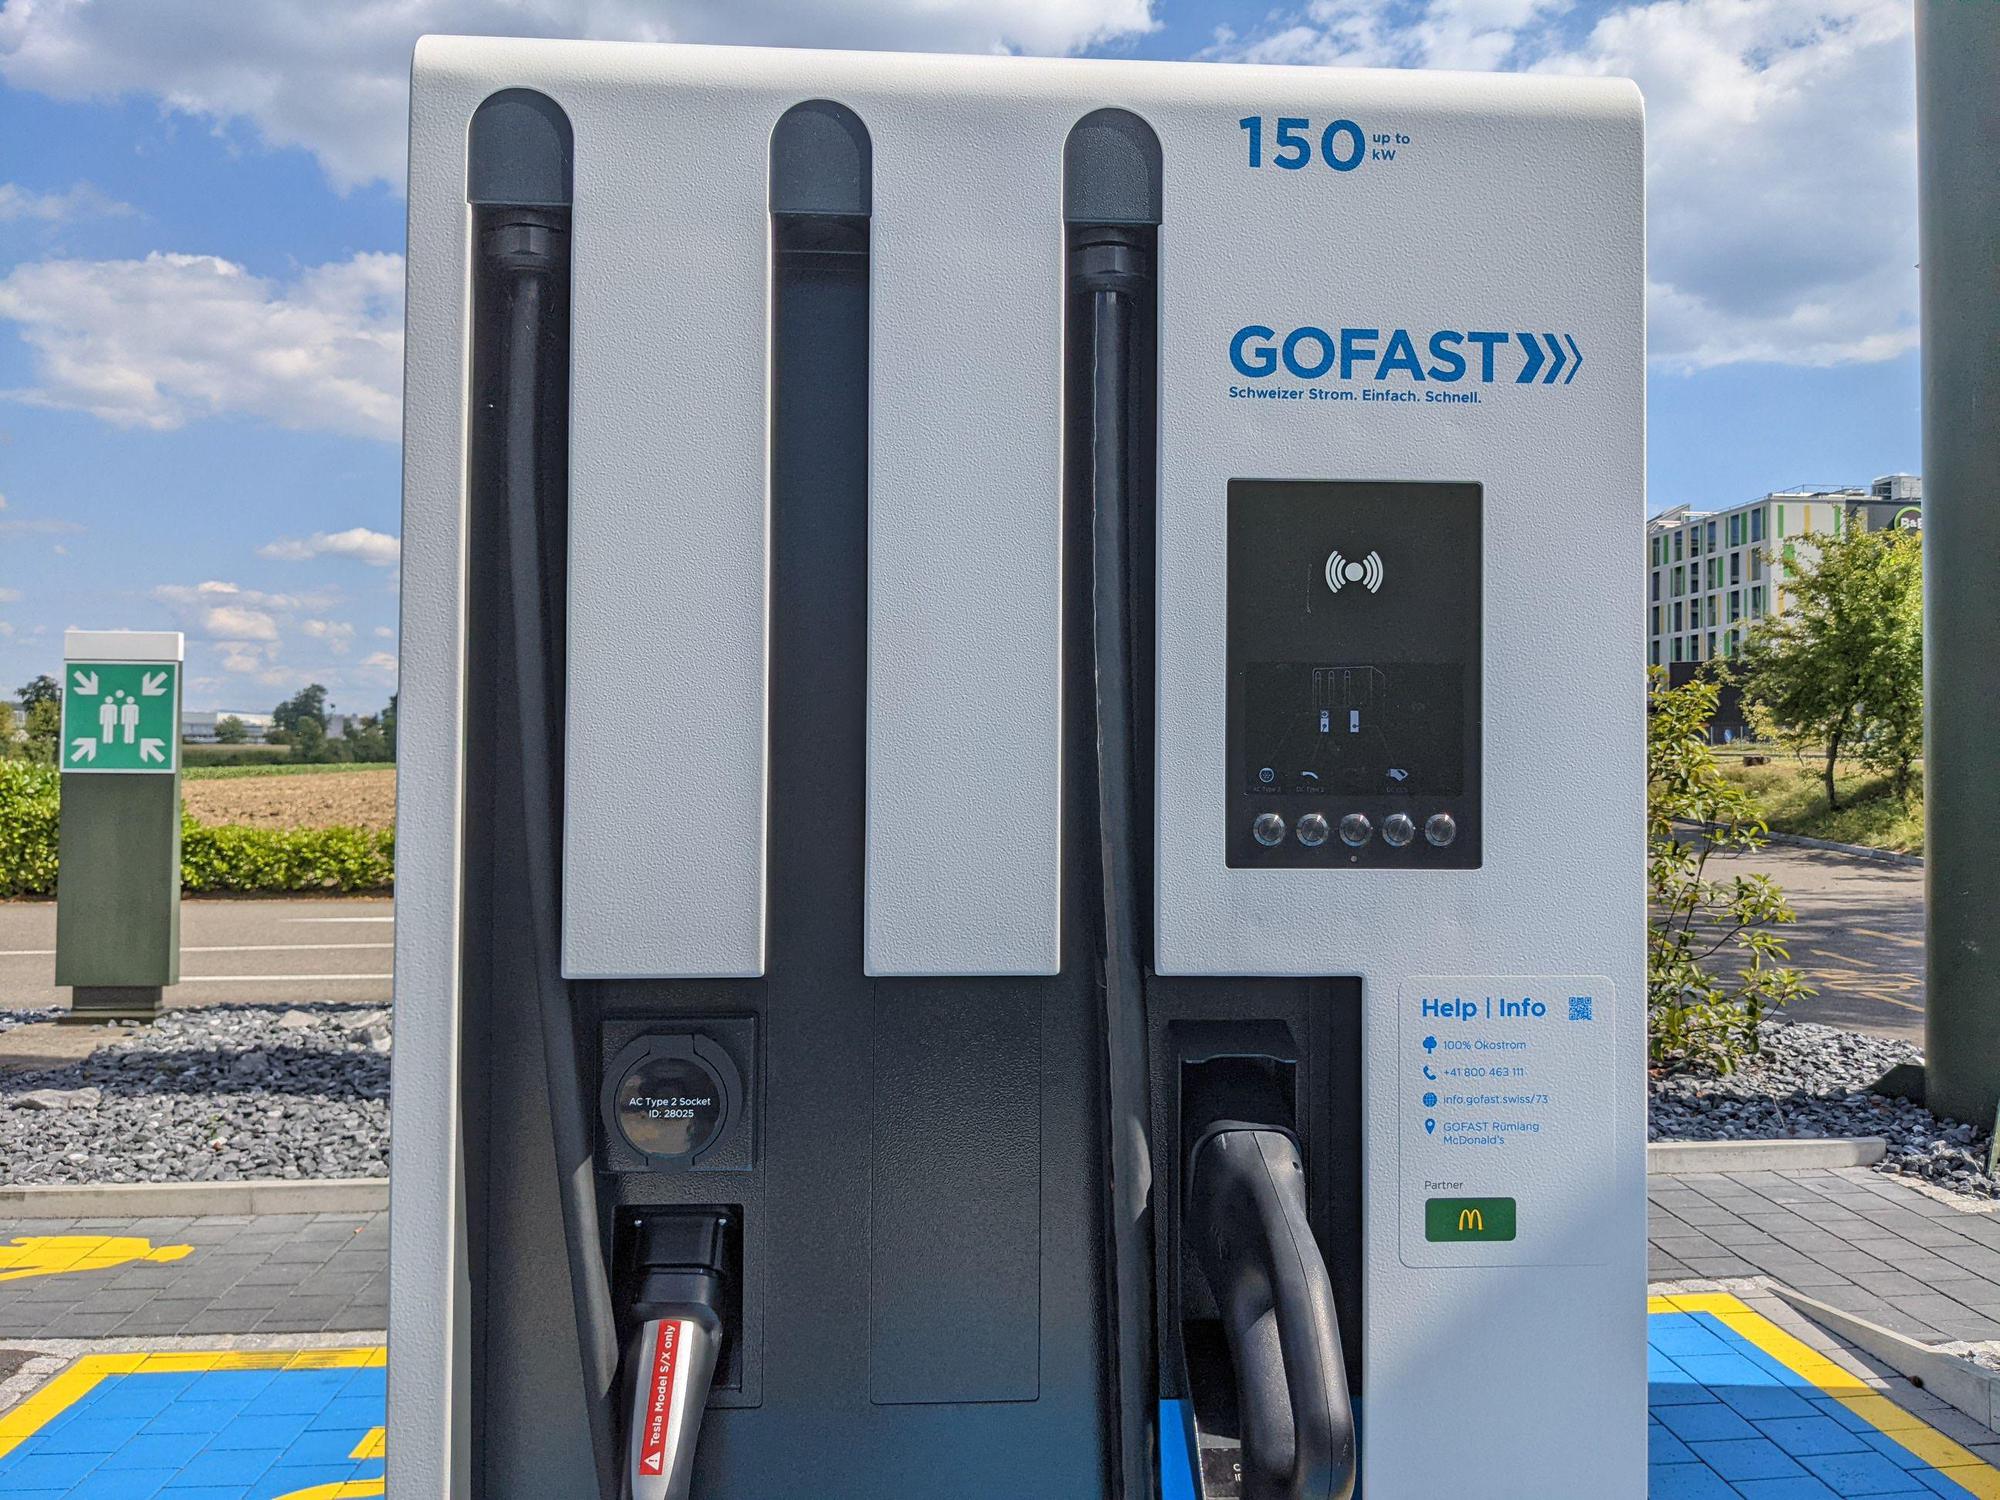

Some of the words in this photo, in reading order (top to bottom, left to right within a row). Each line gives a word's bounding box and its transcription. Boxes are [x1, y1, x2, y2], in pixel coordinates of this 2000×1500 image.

[1238, 116, 1366, 172] 150
[1372, 133, 1391, 146] up
[1395, 133, 1411, 144] to
[1372, 149, 1396, 161] kW
[1229, 325, 1509, 383] GOFAST
[1229, 386, 1305, 400] Schweizer
[1308, 388, 1358, 401] Strom.
[1362, 389, 1420, 402] Einfach.
[1425, 390, 1482, 404] Schnell.
[1422, 998, 1478, 1022] Help
[1499, 997, 1546, 1017] Info
[1443, 1040, 1472, 1050] 100%
[1444, 1067, 1461, 1077] +41
[1464, 1067, 1486, 1077] 800
[1489, 1067, 1510, 1077] 463
[1512, 1067, 1524, 1077] 111
[629, 1097, 643, 1106] AC
[645, 1097, 669, 1108] Type
[671, 1097, 677, 1106] 2
[679, 1097, 711, 1106] Socket
[1443, 1094, 1549, 1106] info.gofast.swiss/73
[649, 1109, 662, 1118] ID:
[664, 1109, 694, 1118] 28025
[1443, 1122, 1489, 1132] GOFAST
[1443, 1135, 1505, 1145] McDonald's
[1424, 1180, 1464, 1190] Partner
[663, 1324, 676, 1349] only
[660, 1351, 671, 1373] S/X
[653, 1376, 668, 1412] Model
[650, 1415, 662, 1446] Tesla
